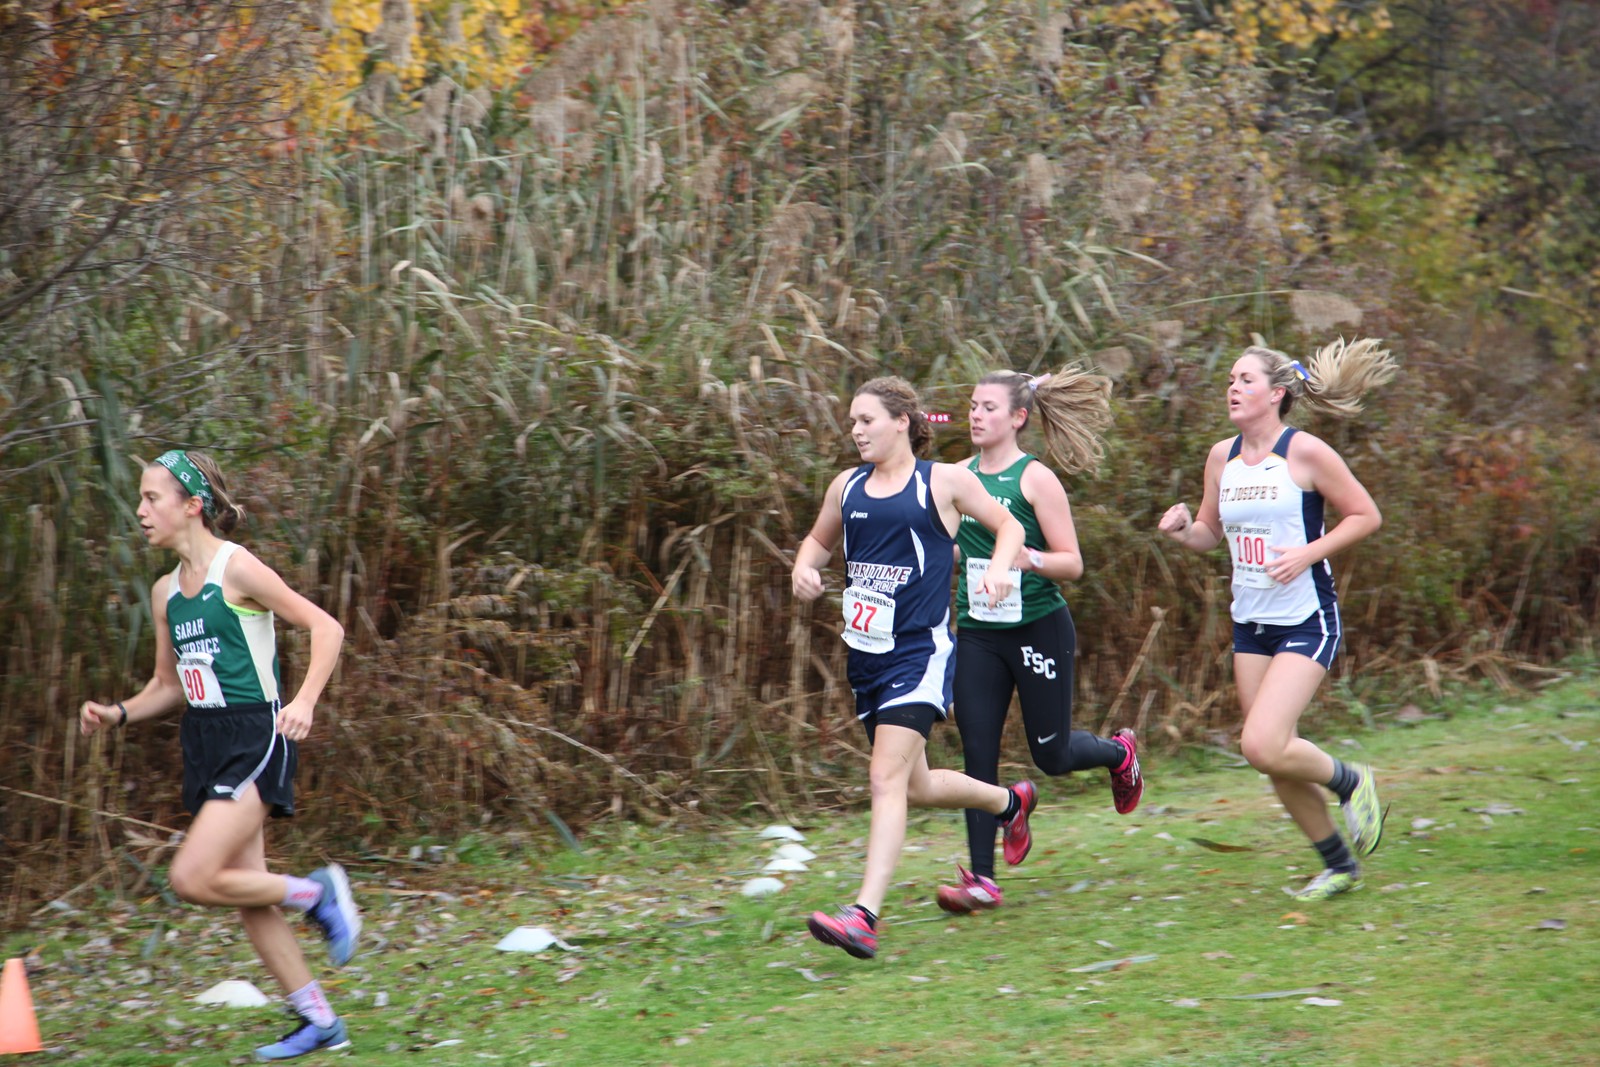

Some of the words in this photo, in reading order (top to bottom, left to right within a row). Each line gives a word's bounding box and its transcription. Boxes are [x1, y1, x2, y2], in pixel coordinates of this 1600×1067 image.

[1236, 535, 1265, 566] 100
[847, 561, 913, 585] MARITIME
[860, 593, 894, 609] CONFERENCE
[175, 617, 205, 641] SARAH
[851, 601, 877, 633] 27
[1020, 645, 1057, 680] FSC
[184, 668, 206, 701] 90
